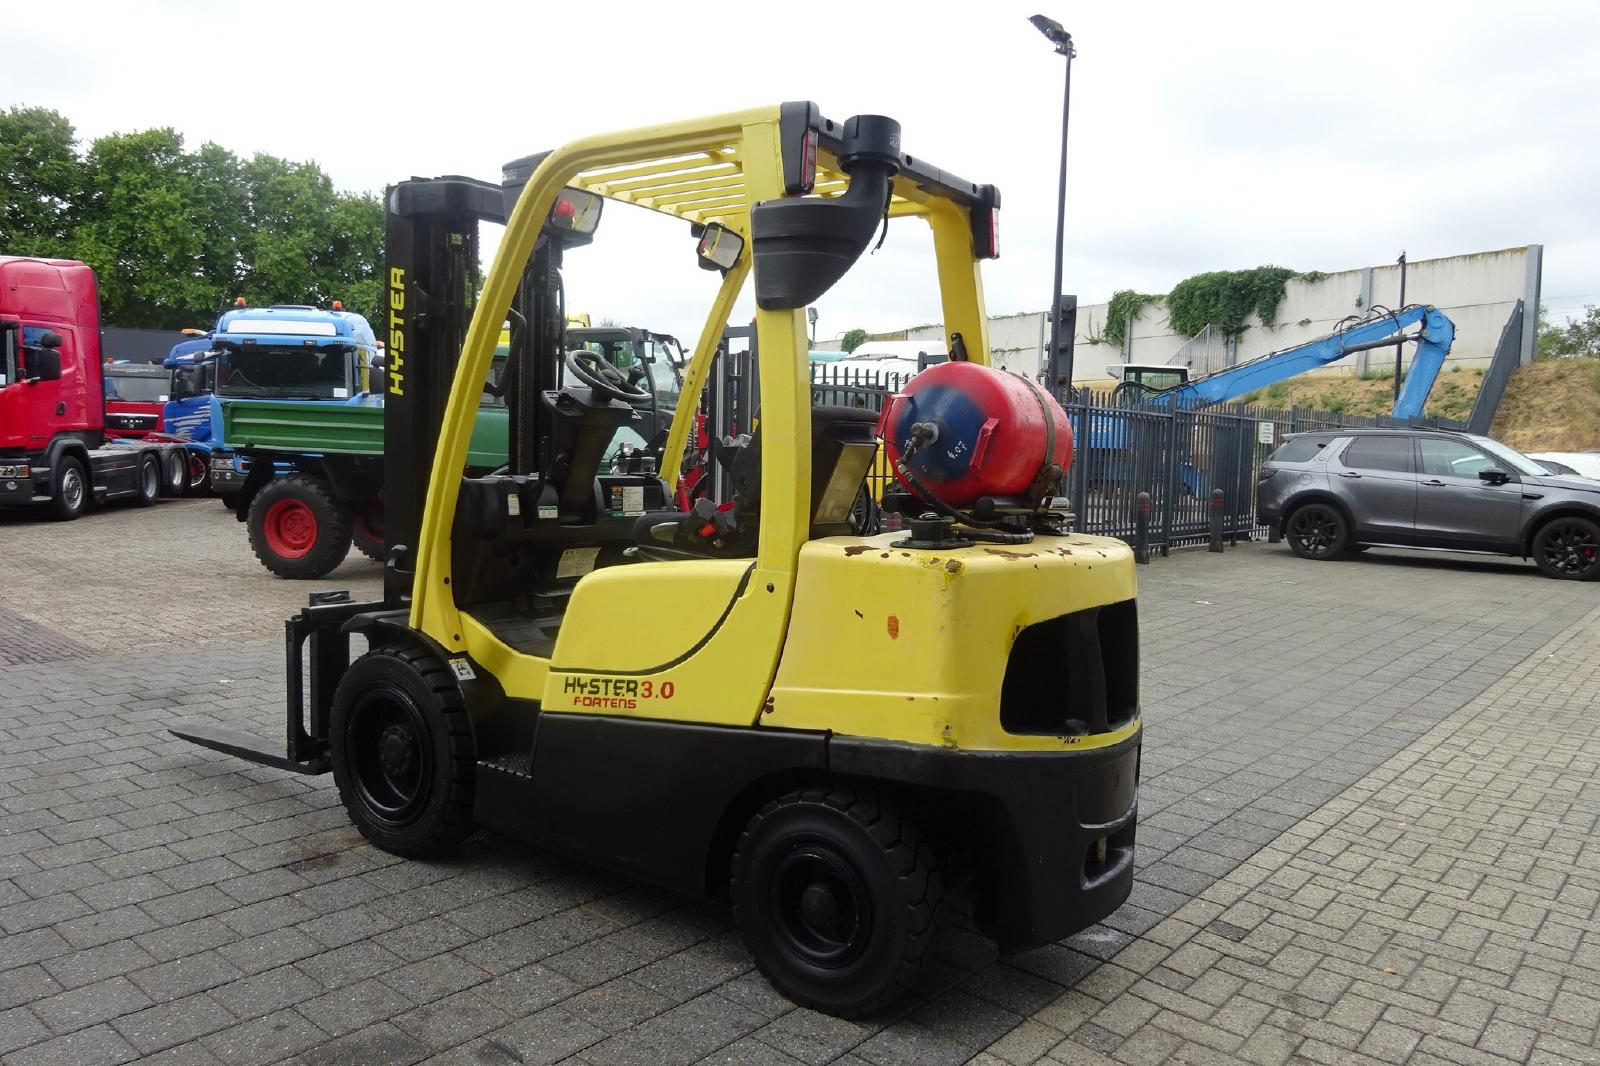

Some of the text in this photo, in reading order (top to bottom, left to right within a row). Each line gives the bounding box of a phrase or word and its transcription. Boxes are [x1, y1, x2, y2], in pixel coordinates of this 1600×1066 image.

[389, 266, 405, 397] HYSTER
[564, 676, 675, 699] HYSTER 3.0
[573, 696, 637, 709] FORTENS
